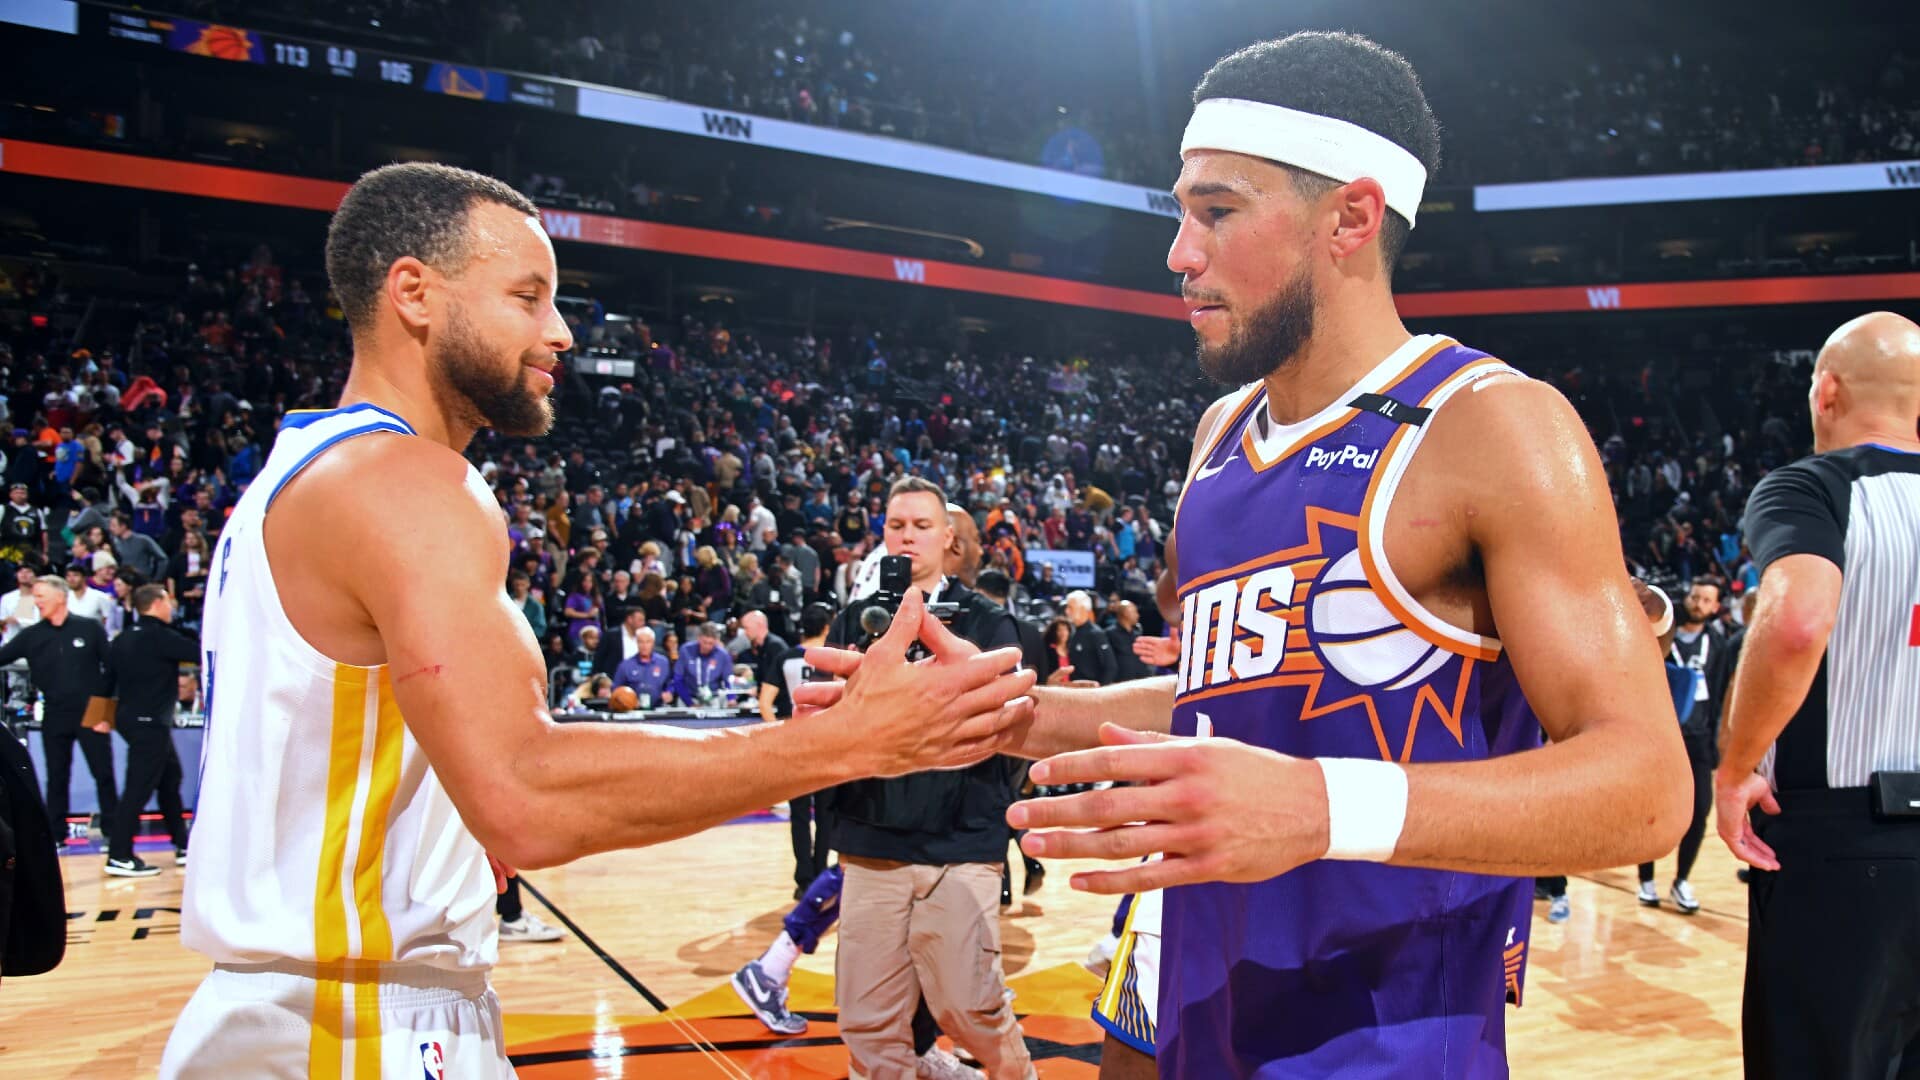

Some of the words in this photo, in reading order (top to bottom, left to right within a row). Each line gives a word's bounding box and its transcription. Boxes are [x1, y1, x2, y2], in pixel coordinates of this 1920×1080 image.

[274, 43, 309, 67] 113
[380, 60, 413, 84] 105
[702, 111, 752, 139] WIN
[1886, 166, 1920, 185] WI
[1379, 400, 1398, 417] AL
[1305, 444, 1379, 470] PayPal
